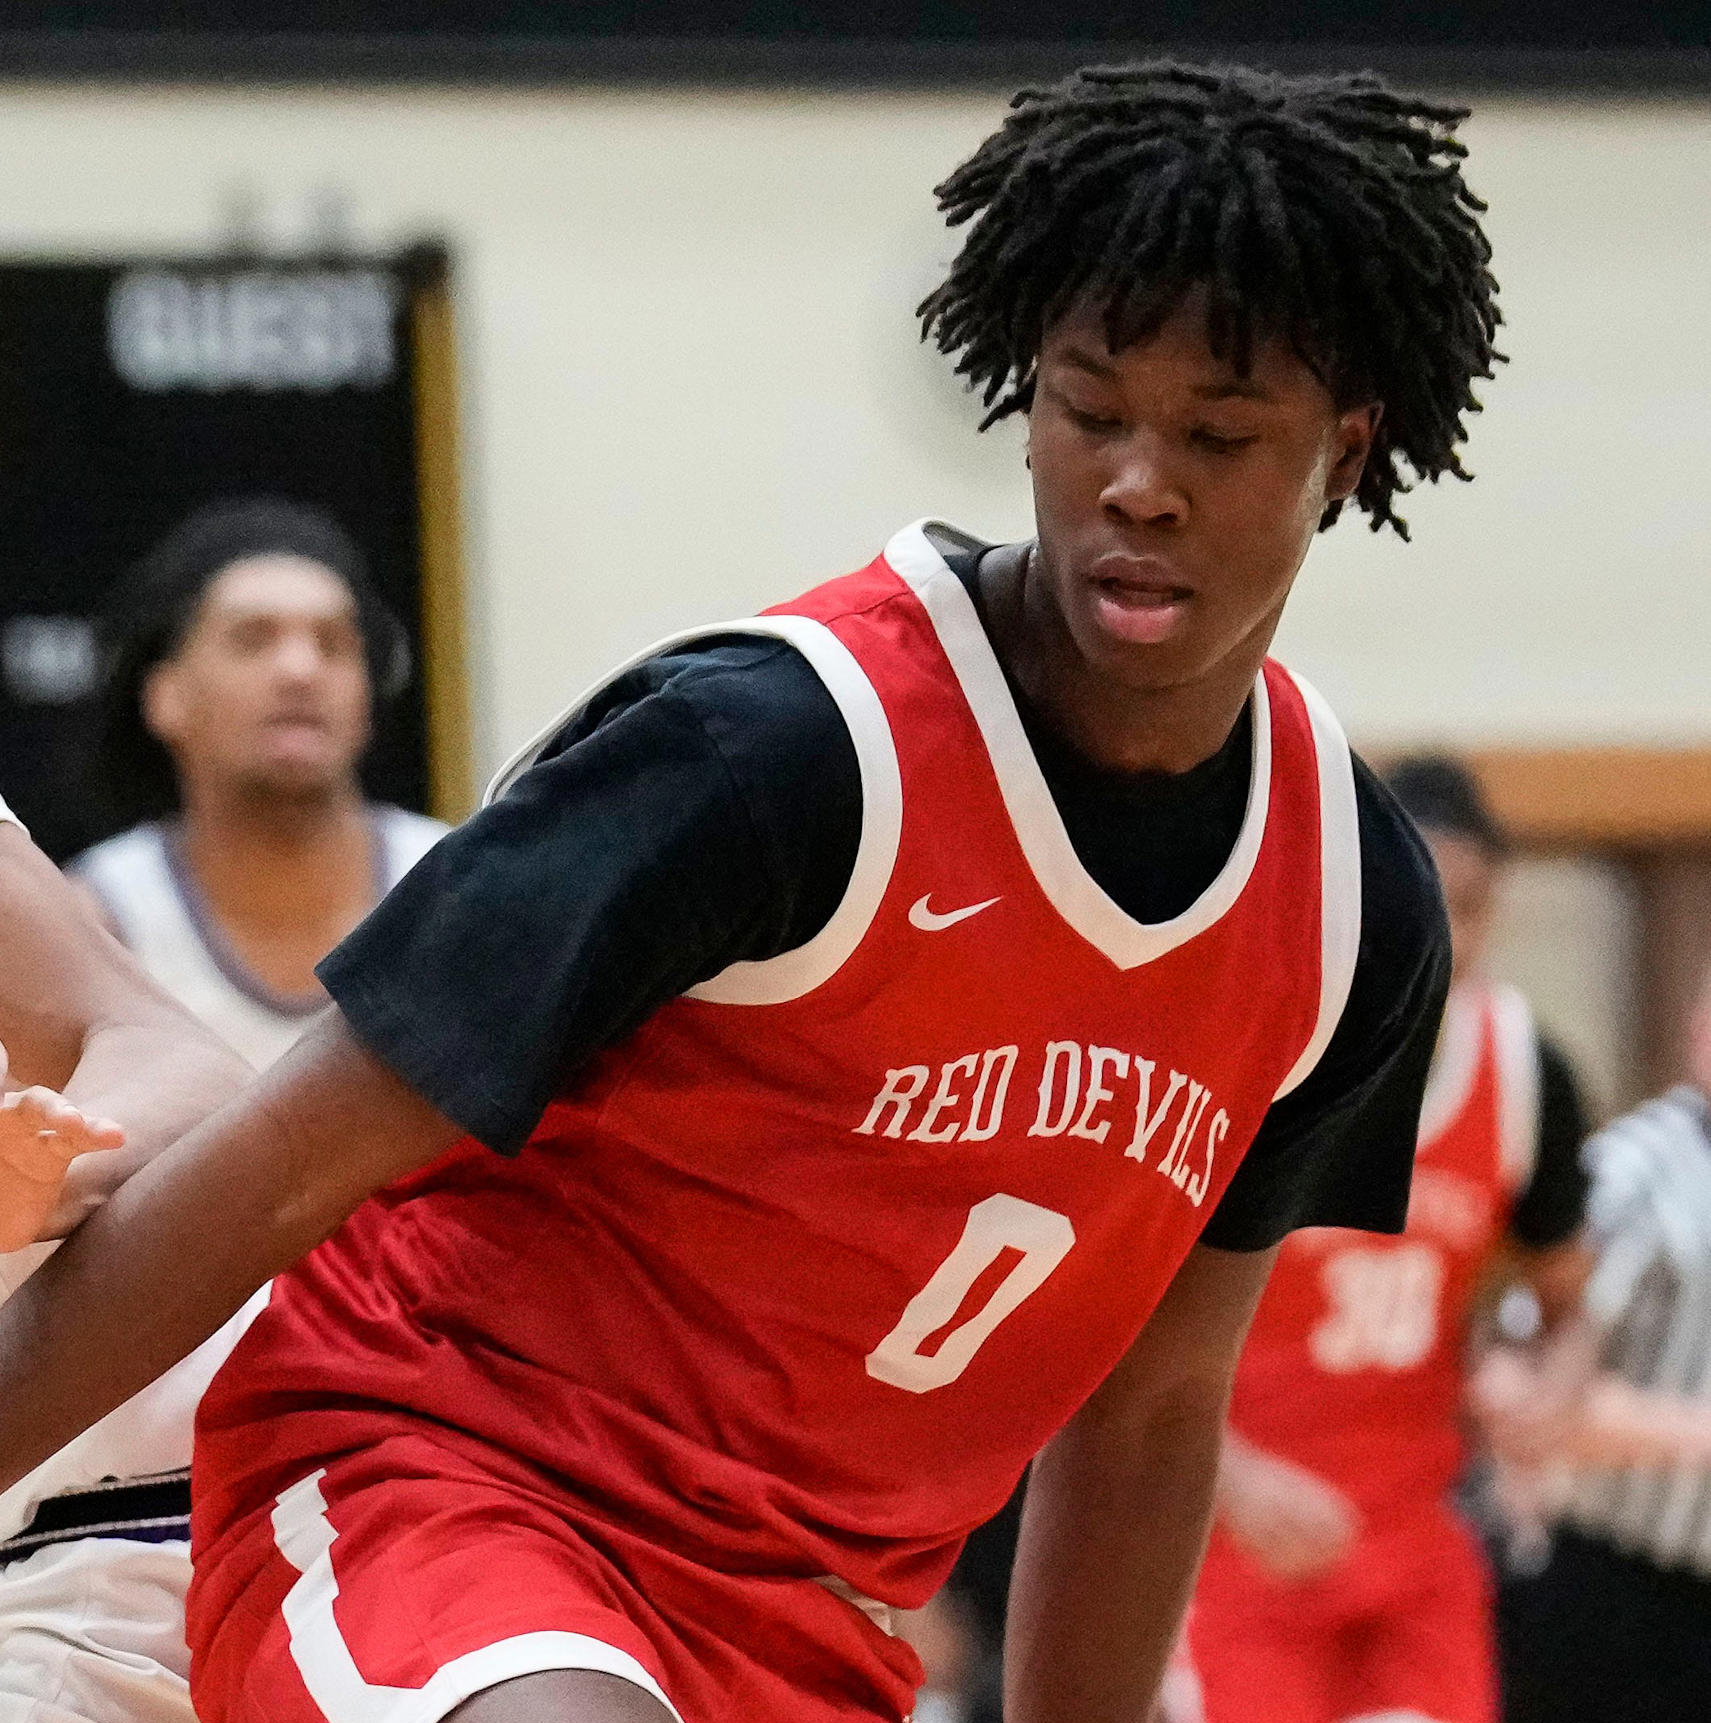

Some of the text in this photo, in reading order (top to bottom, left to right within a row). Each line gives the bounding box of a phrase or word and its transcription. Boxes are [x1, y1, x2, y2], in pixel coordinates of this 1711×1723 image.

[851, 1040, 1230, 1208] RED DEVILS
[864, 1192, 1076, 1394] 0
